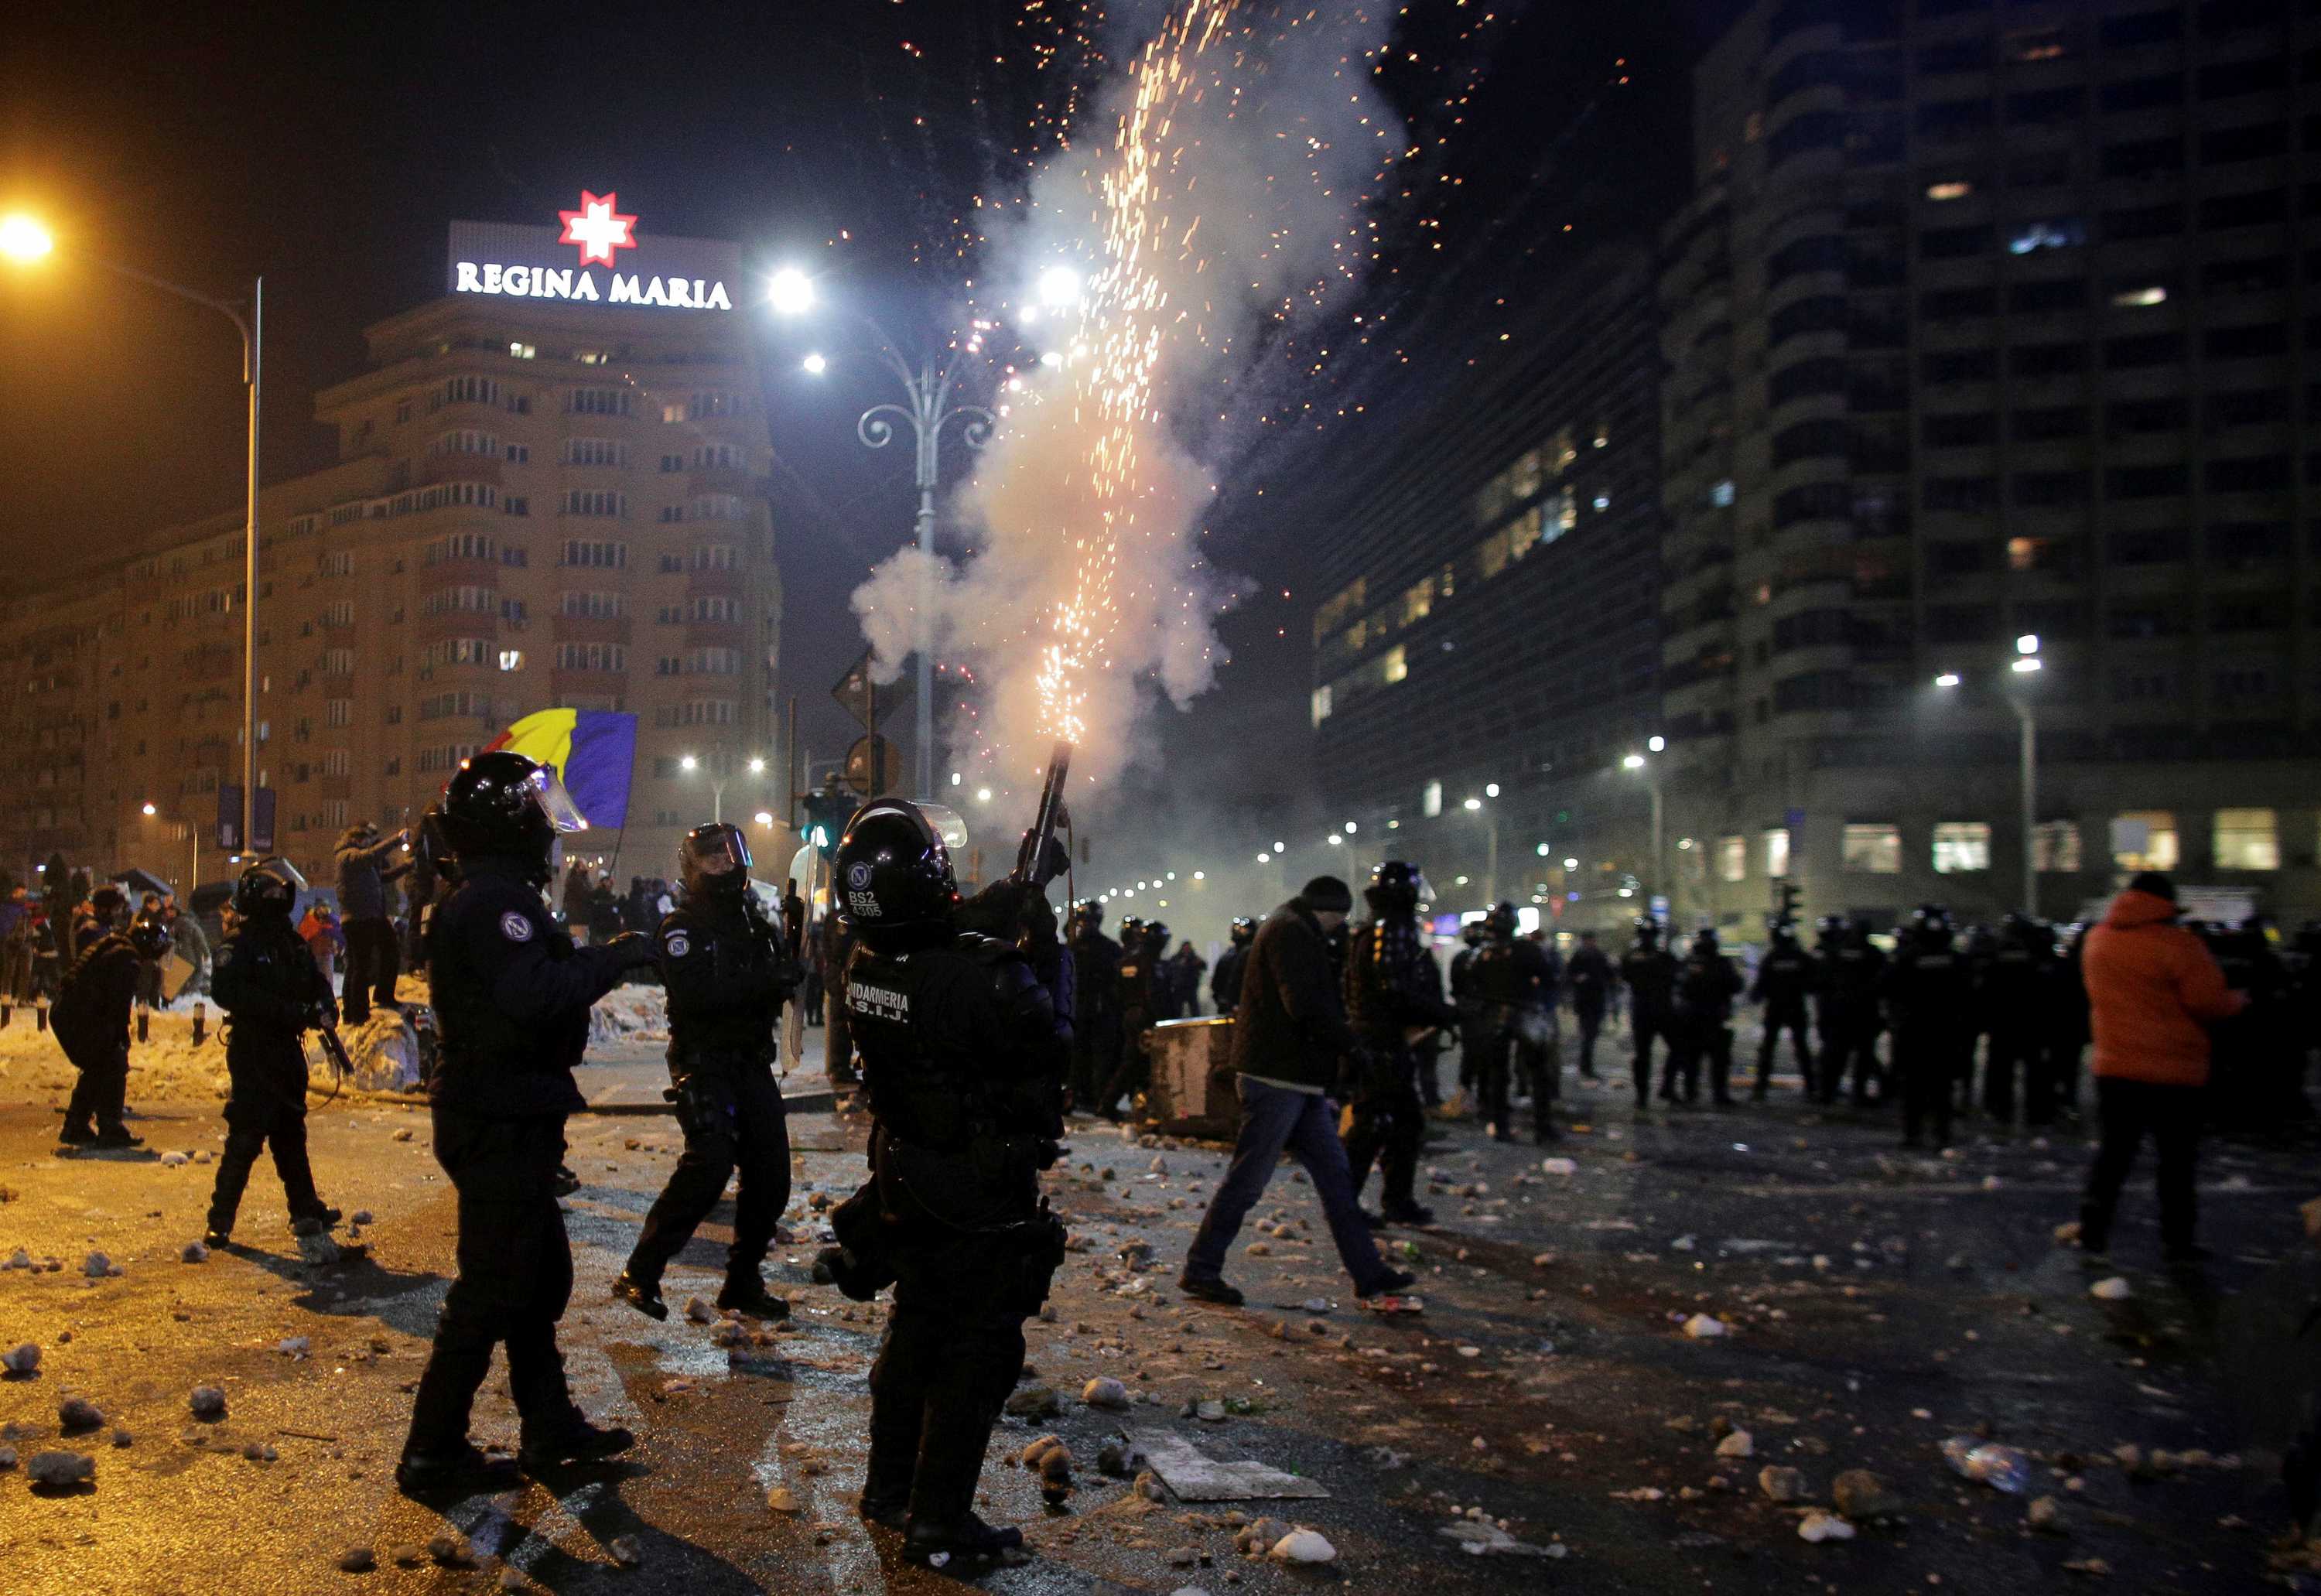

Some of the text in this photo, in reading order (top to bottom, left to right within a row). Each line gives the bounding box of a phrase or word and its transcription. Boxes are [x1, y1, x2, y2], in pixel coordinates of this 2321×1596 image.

[456, 261, 732, 310] REGINA MARIA
[849, 891, 876, 904] BS2
[847, 982, 908, 1012] NDARMERIA
